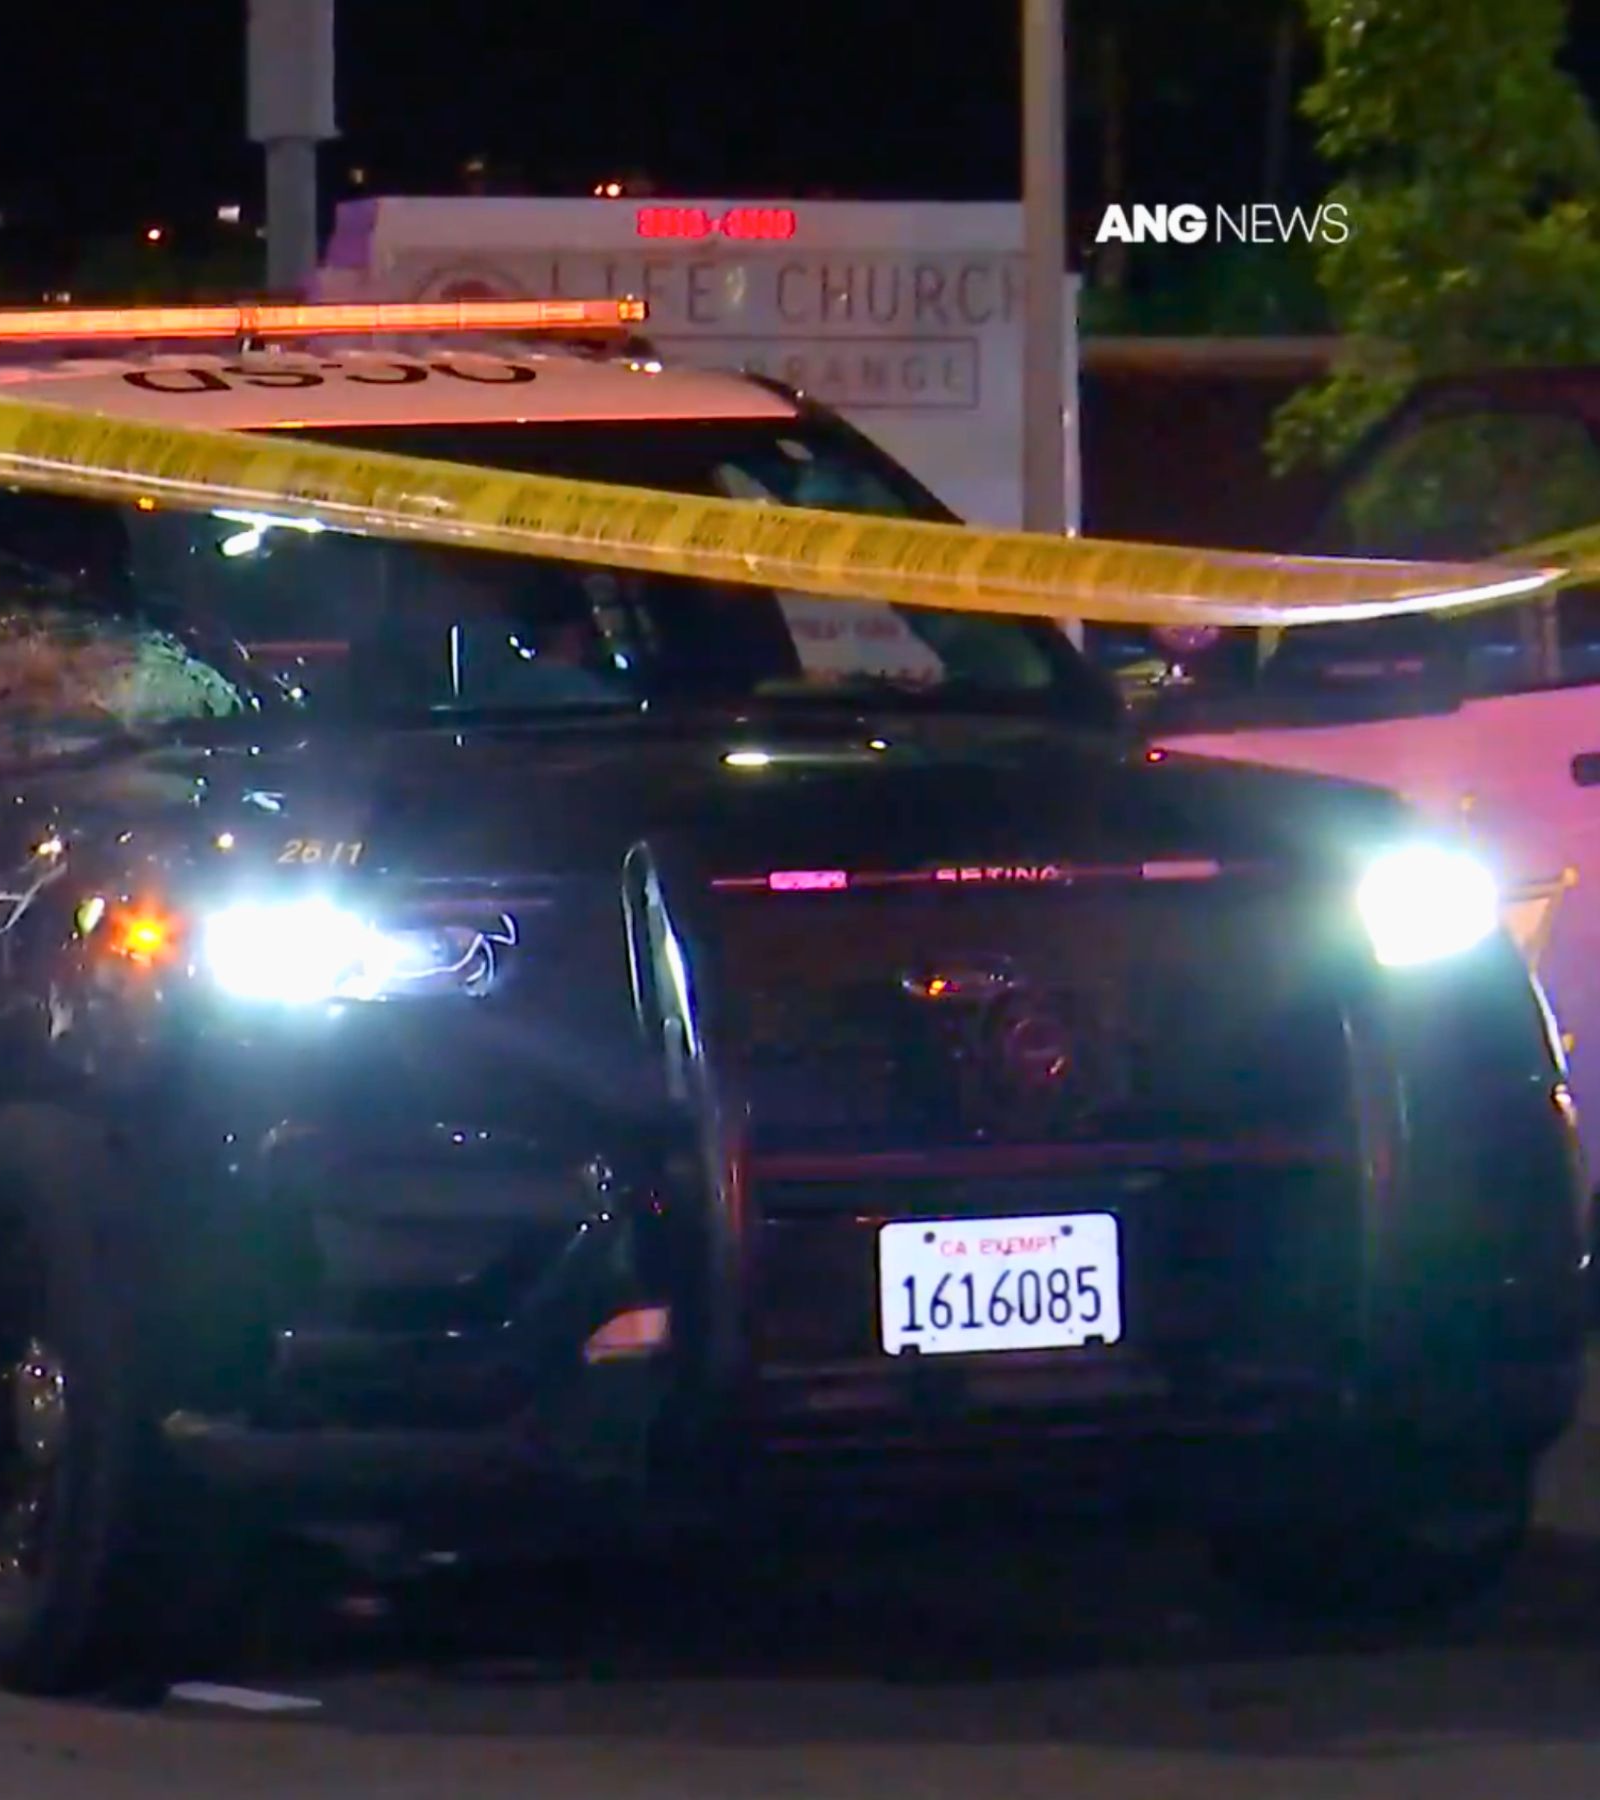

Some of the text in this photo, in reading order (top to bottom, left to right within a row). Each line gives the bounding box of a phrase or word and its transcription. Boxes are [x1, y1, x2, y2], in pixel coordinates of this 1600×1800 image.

[940, 1236, 1059, 1257] CA EXEMPT
[900, 1265, 1102, 1332] 1616085
